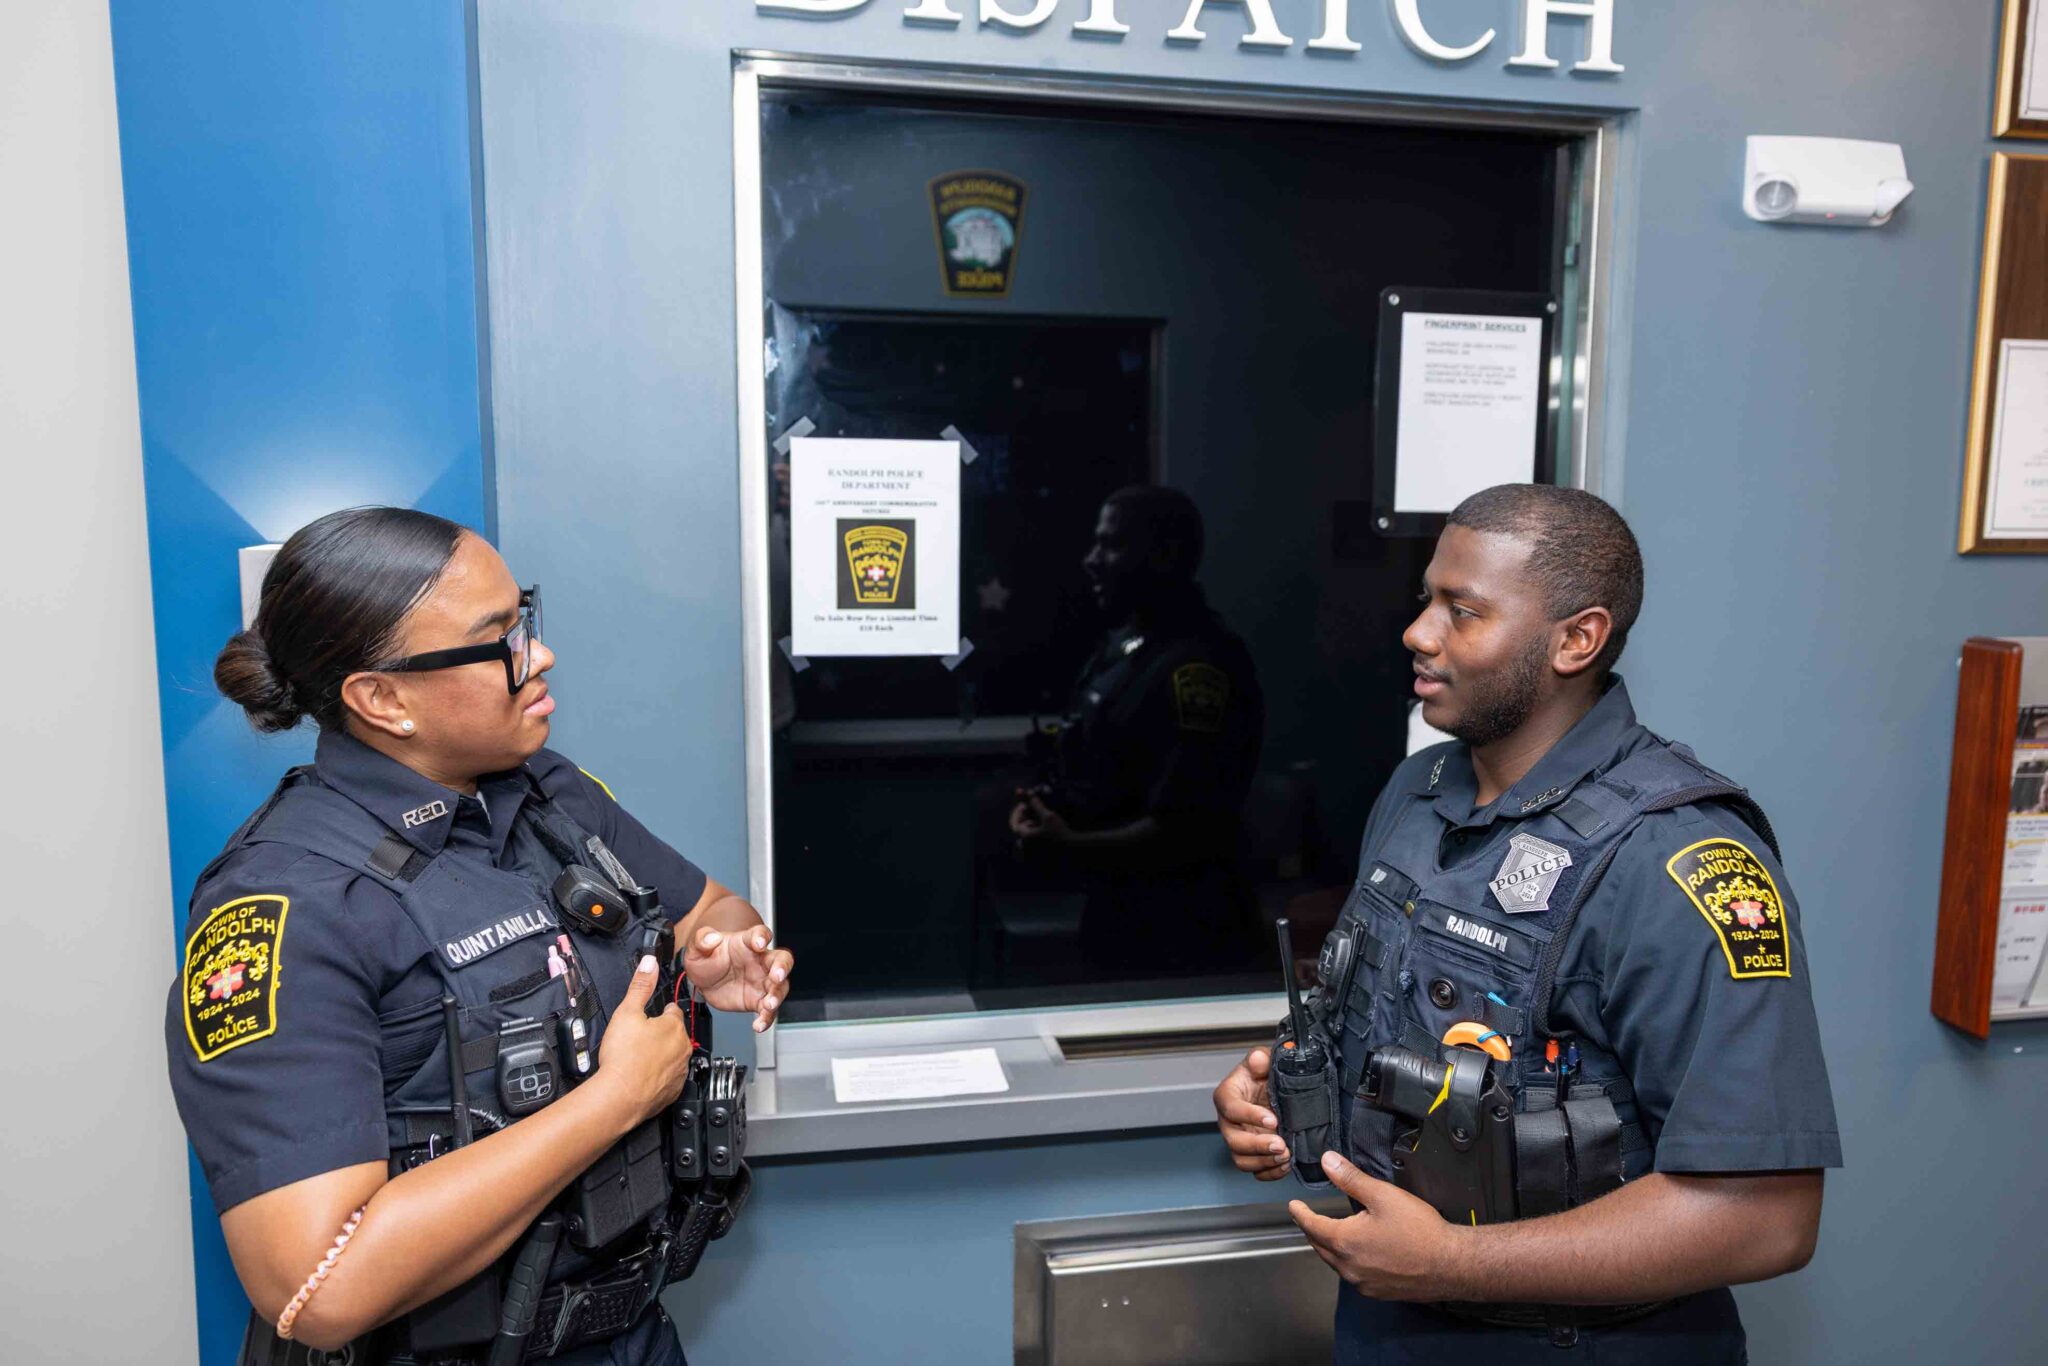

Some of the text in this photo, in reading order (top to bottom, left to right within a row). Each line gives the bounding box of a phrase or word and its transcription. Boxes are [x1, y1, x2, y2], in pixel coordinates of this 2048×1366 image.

[1485, 322, 1526, 333] SERVICES
[828, 469, 924, 478] RANDOLPH POLICE
[841, 481, 911, 490] DEPARTMENT
[1523, 844, 1548, 858] RANDOLPH
[1697, 849, 1731, 863] TOWN
[1494, 855, 1567, 891] POLICE
[205, 906, 257, 937] TOWN OF
[446, 910, 551, 964] QUINTANILLA
[1446, 915, 1508, 953] RANDOLPH
[189, 917, 275, 974] RANDOLPH
[1744, 955, 1783, 968] POLICE
[207, 1016, 258, 1047] POLICE
